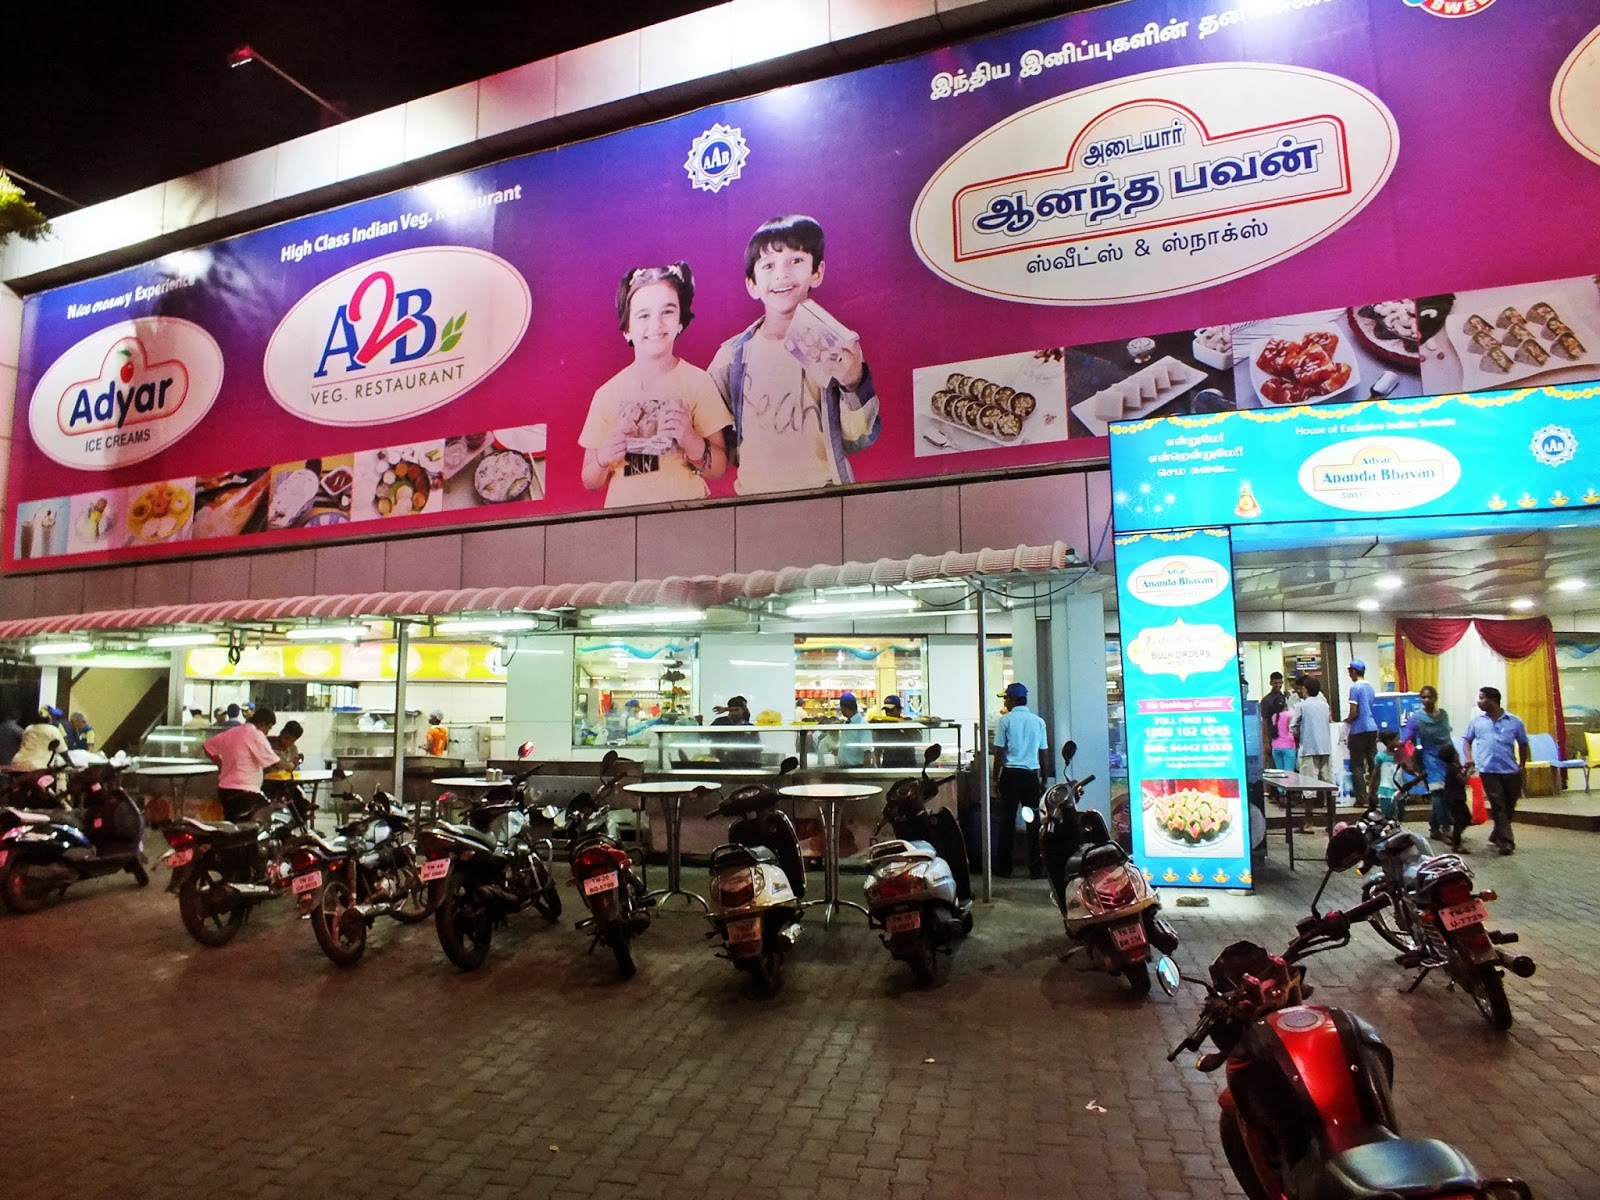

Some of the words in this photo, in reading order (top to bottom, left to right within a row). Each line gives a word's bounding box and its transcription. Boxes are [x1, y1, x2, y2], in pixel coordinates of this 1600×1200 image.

[929, 61, 1010, 101] இந்திய
[1019, 17, 1189, 79] இனிப்புகளின்
[703, 146, 730, 171] AAB
[1083, 120, 1183, 166] அடையார்
[975, 174, 1157, 233] ஆனந்த
[1174, 138, 1318, 195] பவன்
[280, 242, 312, 262] High
[314, 230, 350, 253] Class
[352, 219, 398, 244] Indian
[400, 210, 433, 231] Veg.
[1026, 241, 1124, 275] ஸ்வீட்ஸ்
[1134, 239, 1152, 257] &
[1162, 217, 1270, 257] ஸ்நாக்ஸ்
[313, 271, 437, 378] A2B
[311, 387, 348, 405] VEG.
[355, 364, 465, 399] RESTAURANT
[69, 378, 173, 429] Adyar
[85, 437, 103, 452] ICE
[105, 428, 151, 449] CREAMS
[1296, 426, 1326, 436] House
[1327, 425, 1339, 434] of
[1323, 470, 1376, 484] Ananda
[1381, 468, 1435, 481] Bhavan
[1142, 578, 1177, 588] Ananda
[1179, 576, 1213, 587] Bhavan
[1151, 652, 1174, 660] BULK
[1176, 650, 1211, 659] ORDERS
[1145, 727, 1174, 737] 1800
[1177, 726, 1198, 736] 102
[1200, 725, 1230, 736] 4545
[1153, 717, 1176, 725] TOLL
[1178, 716, 1202, 724] FREE
